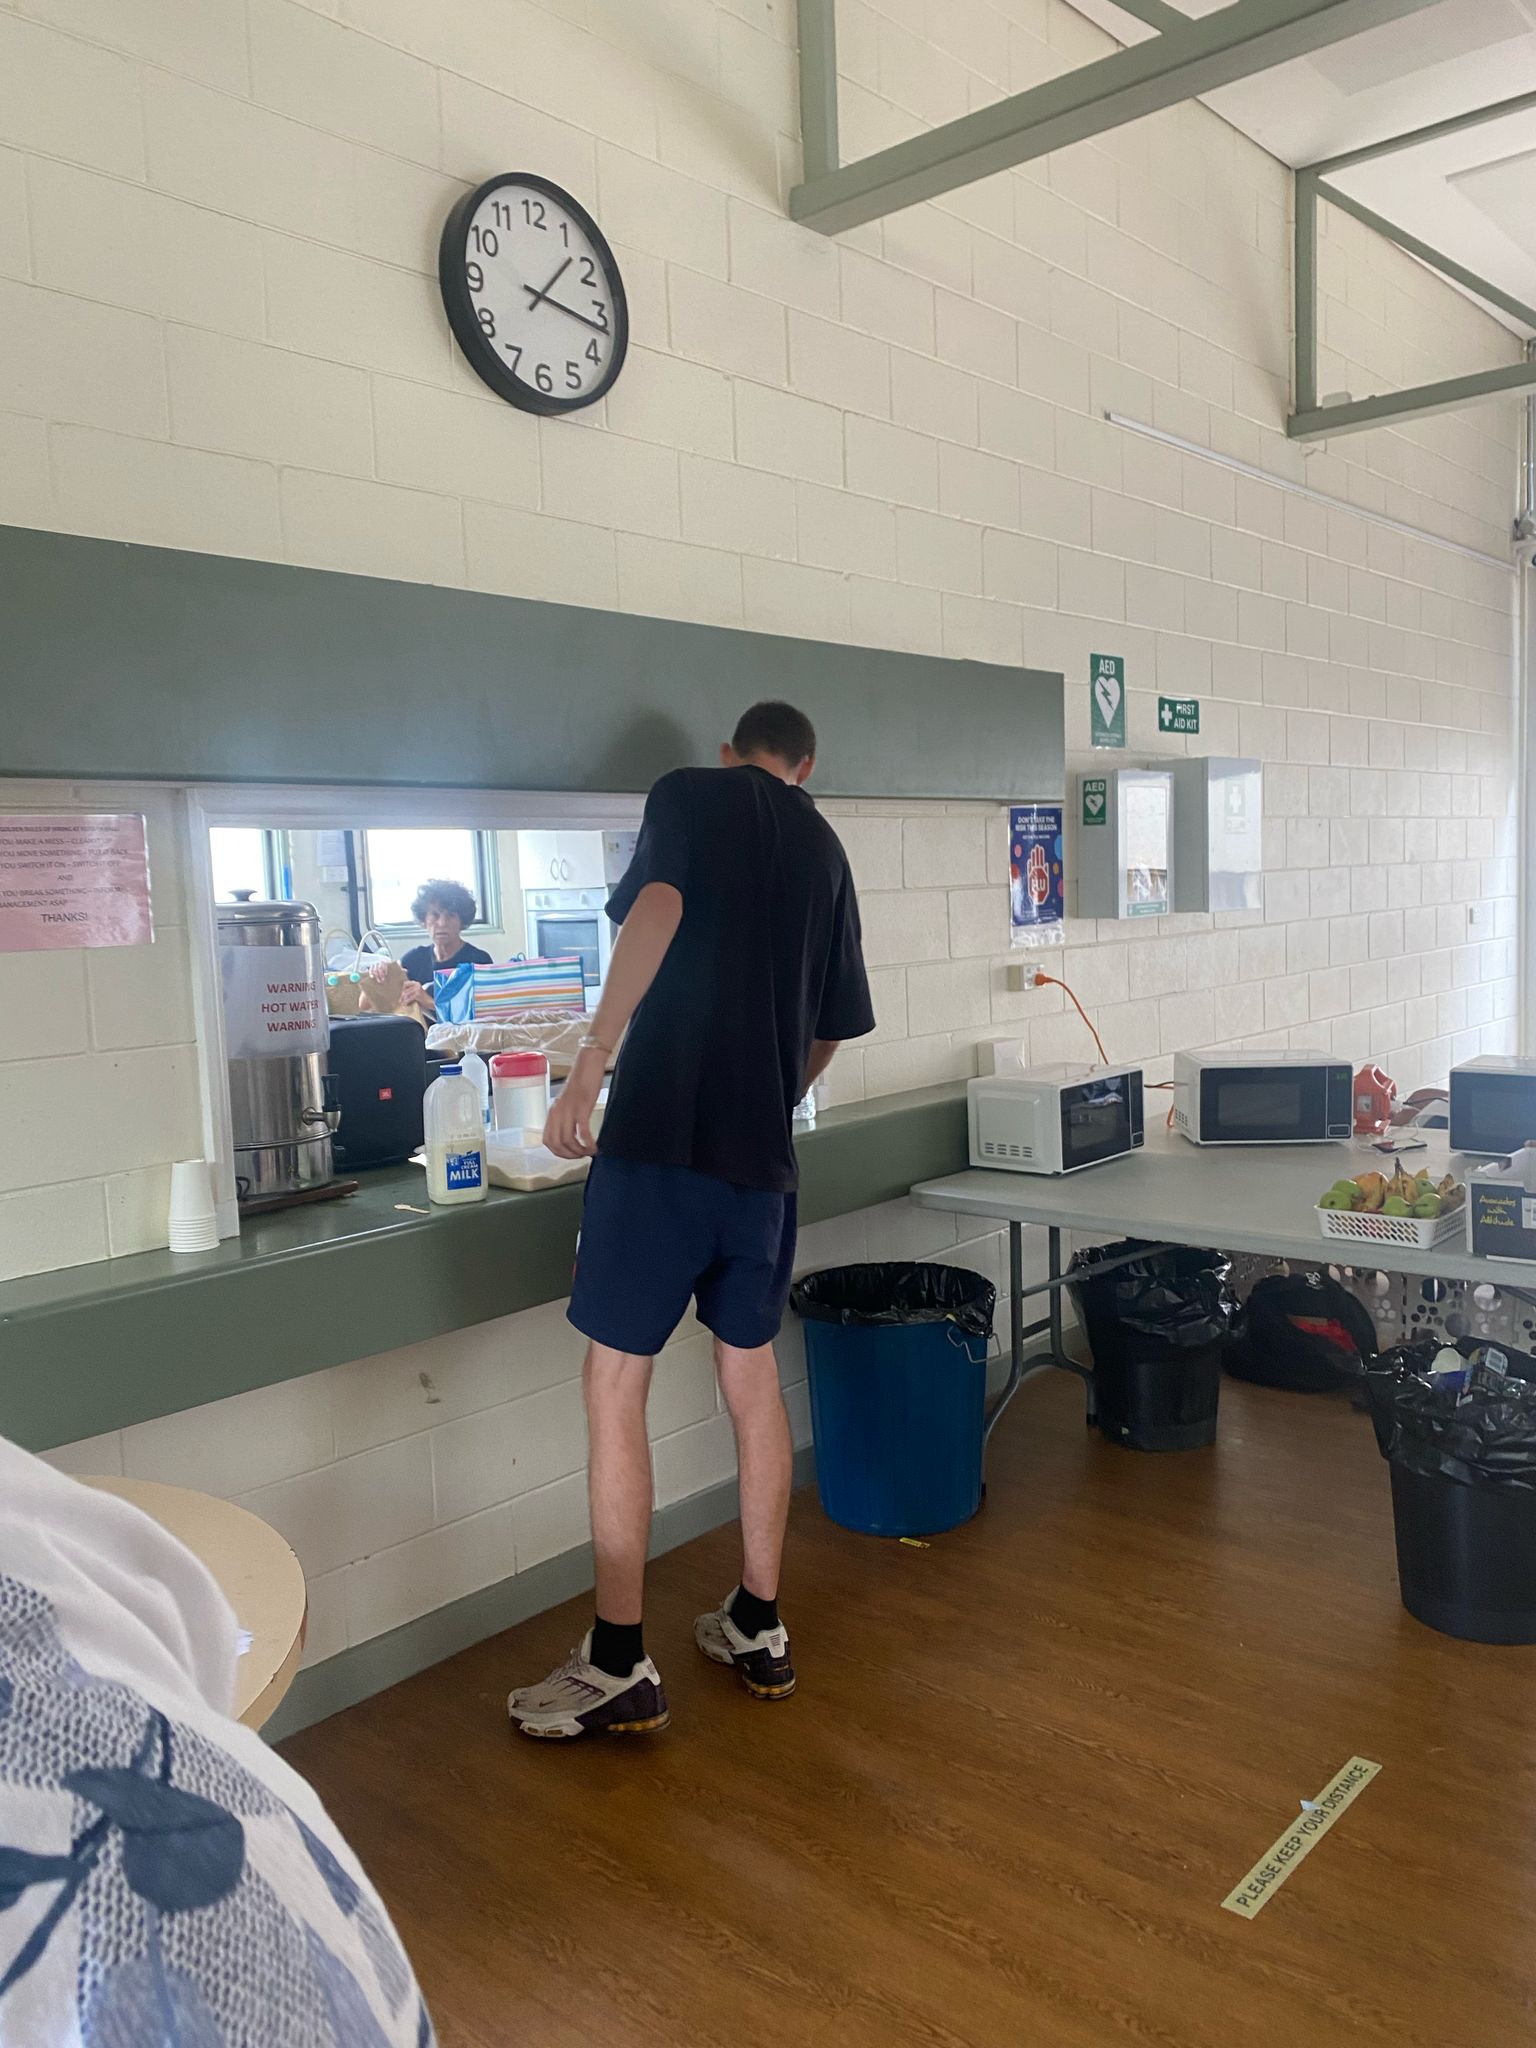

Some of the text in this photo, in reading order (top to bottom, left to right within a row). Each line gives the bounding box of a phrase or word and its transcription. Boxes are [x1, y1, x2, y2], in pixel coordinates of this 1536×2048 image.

[491, 201, 511, 231] 11
[521, 199, 547, 231] 12
[471, 224, 499, 257] 10
[559, 222, 569, 248] 1
[466, 262, 483, 293] 9
[579, 256, 597, 288] 2
[478, 307, 496, 339] 8
[592, 300, 608, 330] 3
[504, 343, 523, 373] 7
[585, 338, 602, 366] 4
[535, 363, 553, 392] 6
[565, 360, 582, 390] 5
[1099, 658, 1115, 675] AED
[1176, 703, 1195, 716] FIRST
[1174, 717, 1198, 731] AID KIT
[1084, 781, 1105, 793] AED
[41, 912, 88, 924] THANKS!
[267, 981, 316, 994] WARNING
[261, 1000, 319, 1013] HOT WATER
[267, 1019, 316, 1032] WARNING
[450, 1168, 479, 1181] MILK
[1236, 1764, 1369, 1908] PLEASE KEEP YOUR DISTANCE
